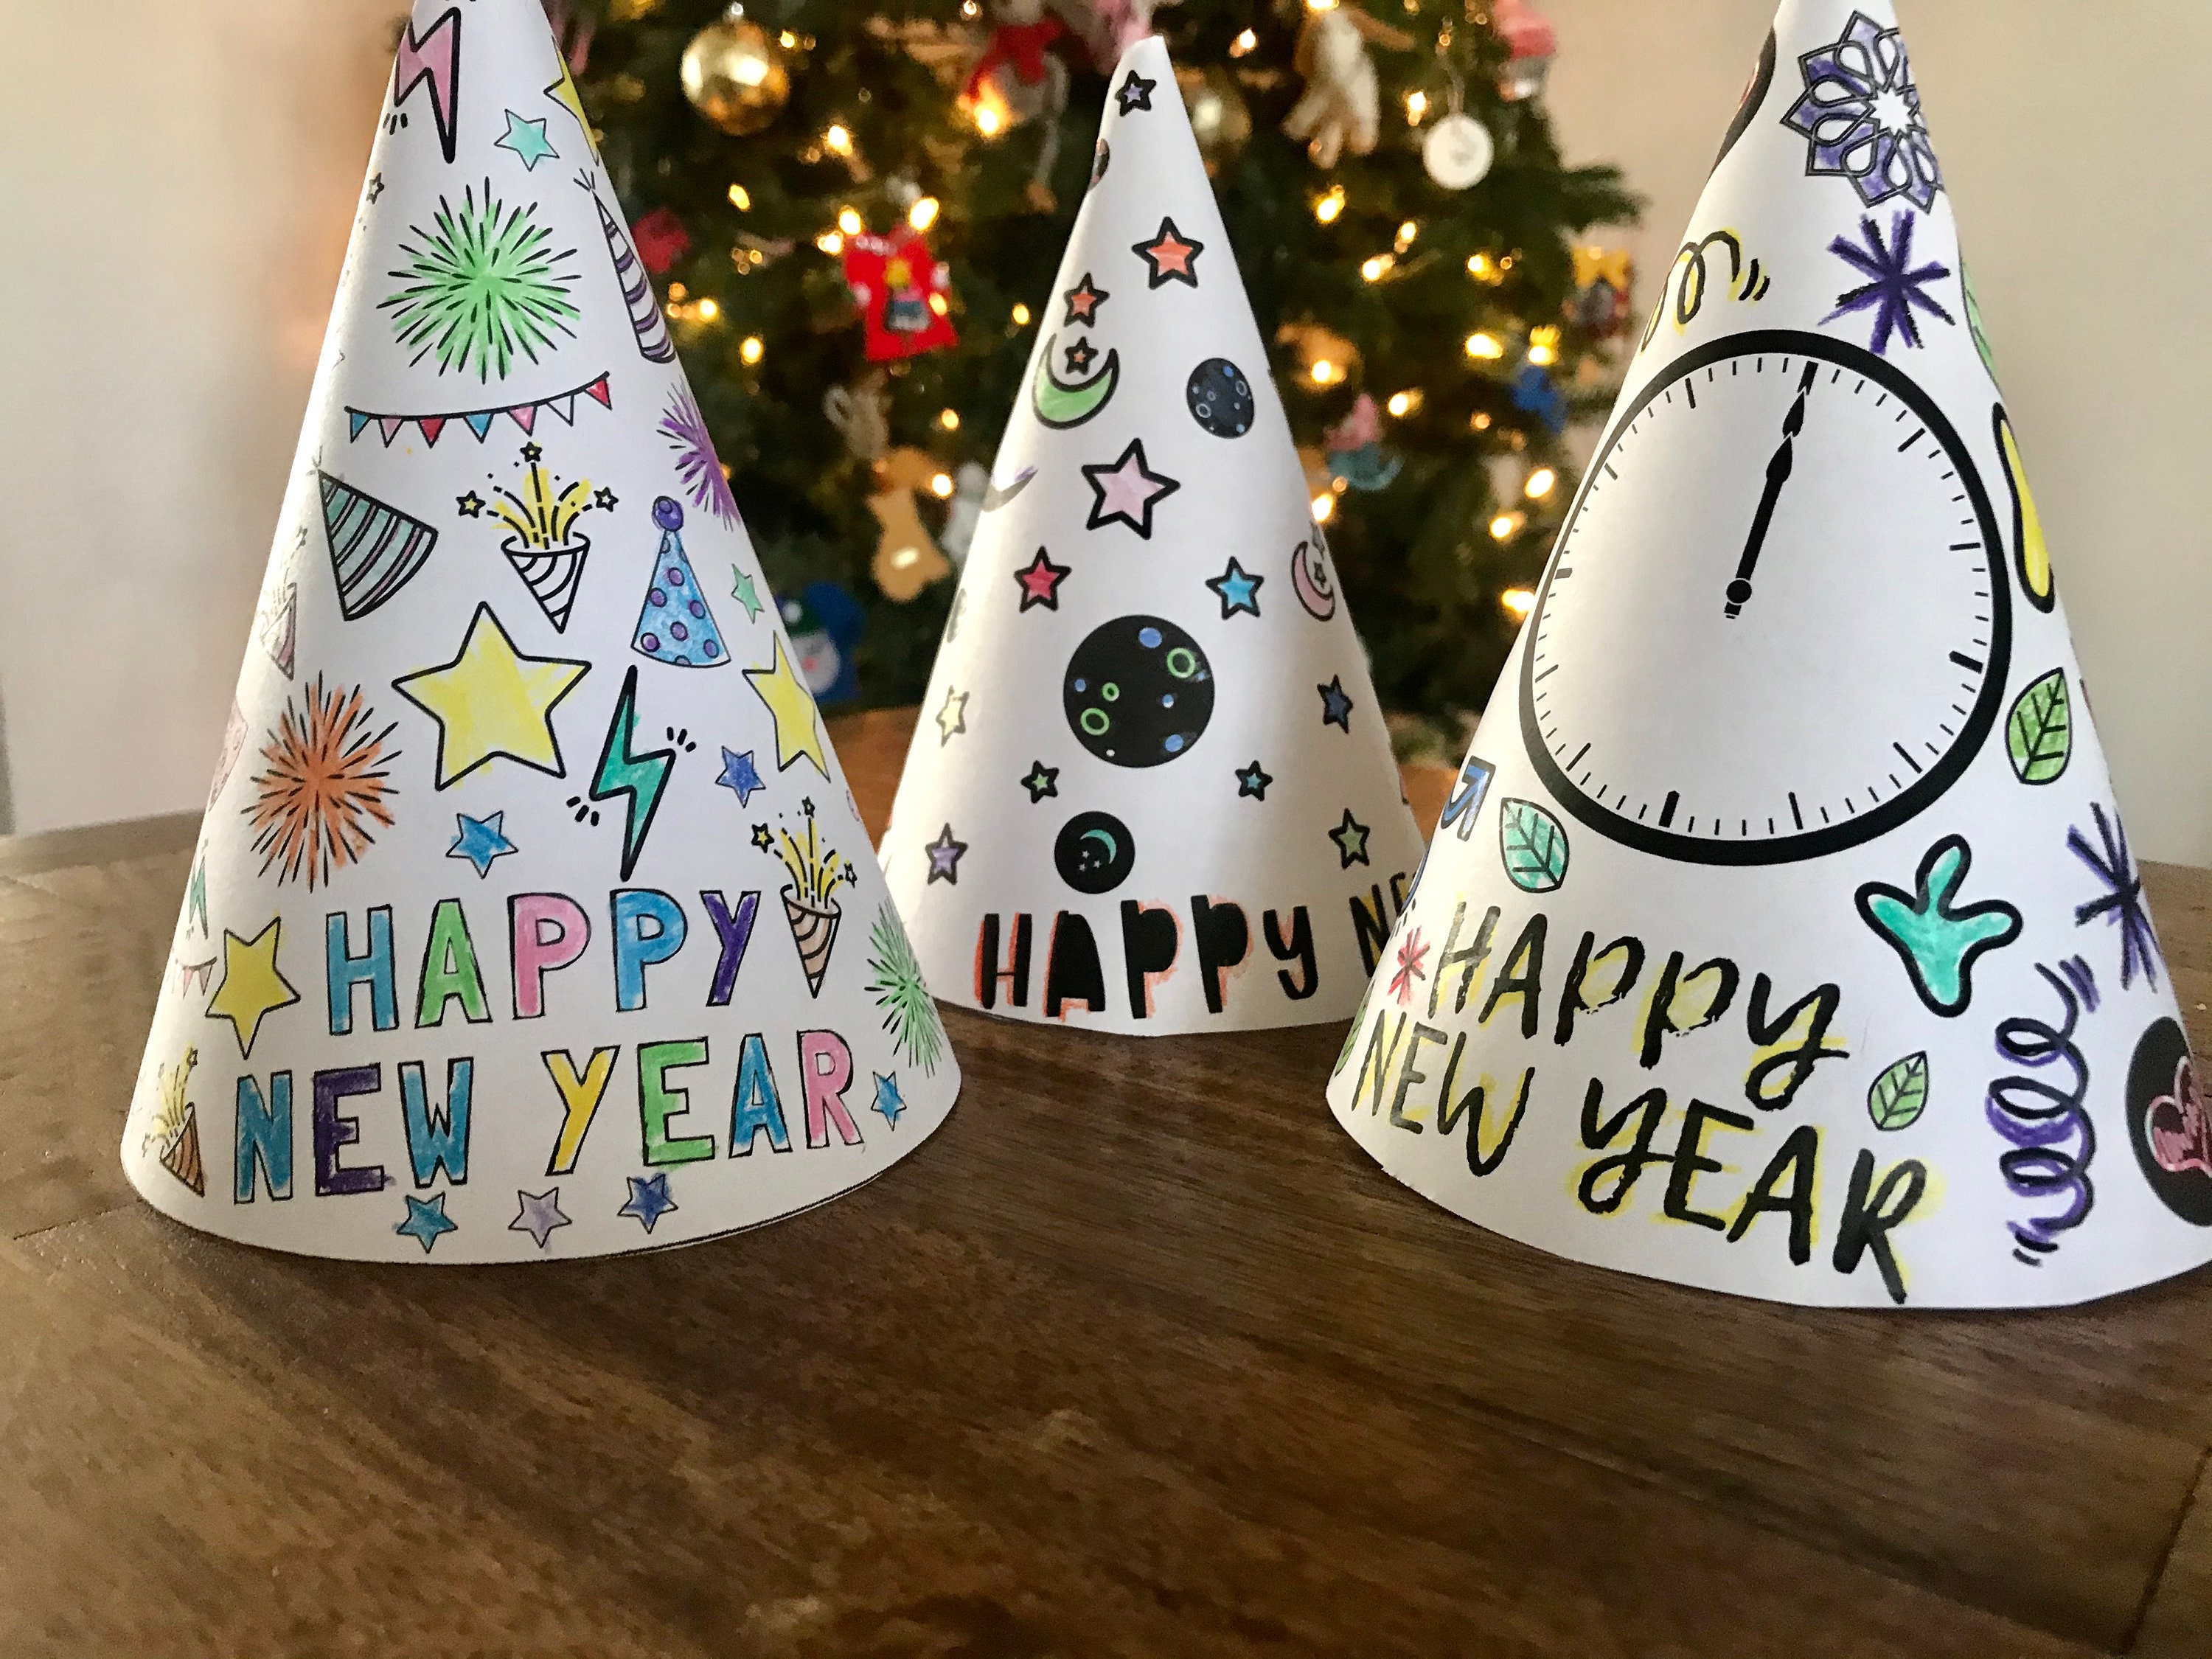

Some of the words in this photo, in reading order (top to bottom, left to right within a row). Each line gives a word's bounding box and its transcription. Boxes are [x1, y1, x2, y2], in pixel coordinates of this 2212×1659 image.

[326, 889, 760, 1035] HAPPY
[977, 894, 1319, 1019] HAPPY
[233, 1057, 473, 1204] NEW
[540, 1029, 863, 1178] YEAR
[1352, 1011, 1536, 1178] NEW
